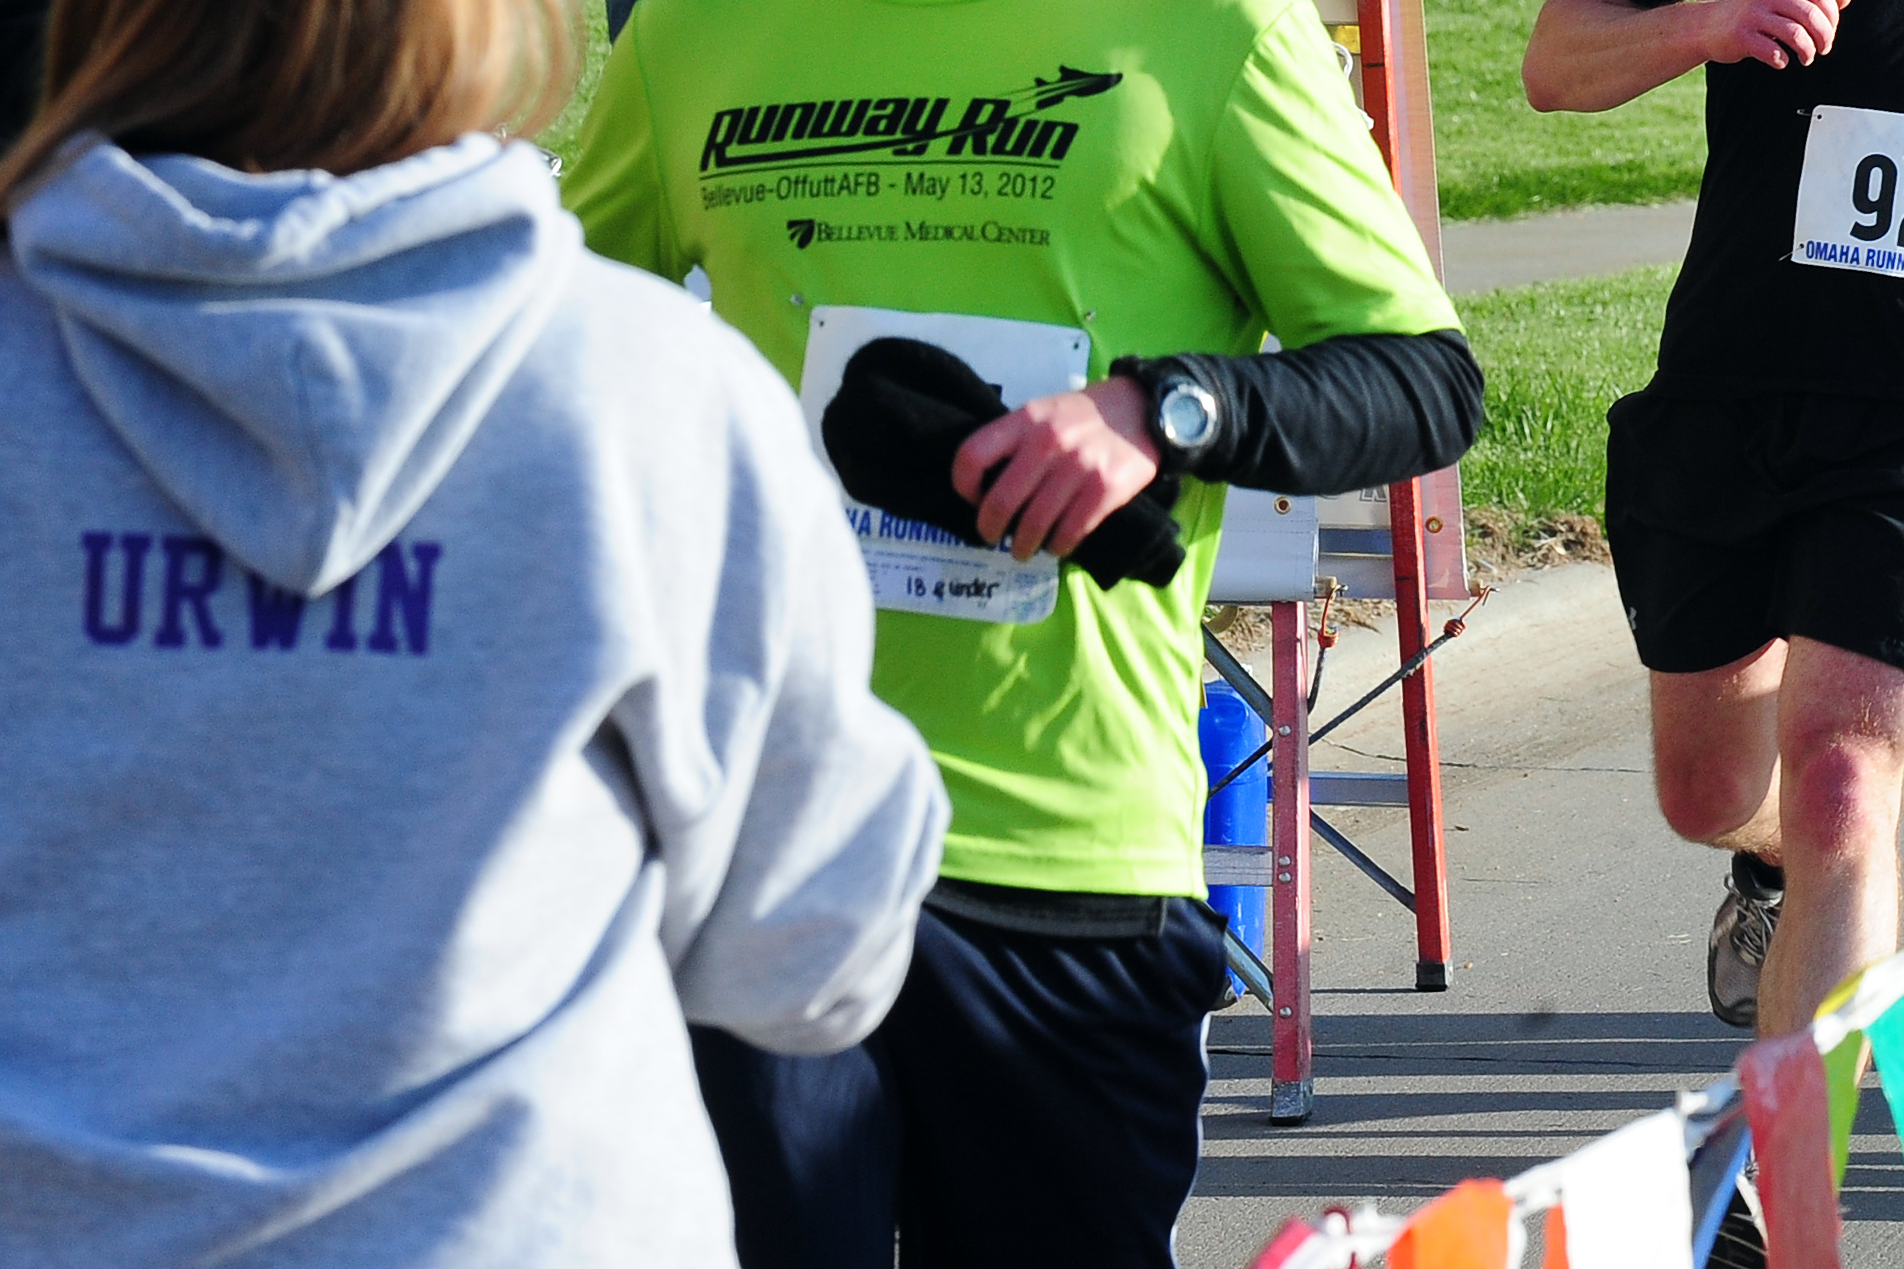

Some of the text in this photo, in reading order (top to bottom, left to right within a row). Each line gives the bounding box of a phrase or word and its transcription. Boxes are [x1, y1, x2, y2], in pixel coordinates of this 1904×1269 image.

[946, 97, 1079, 160] Run
[904, 172, 950, 200] May
[959, 172, 989, 199] 13,
[997, 173, 1056, 200] 2012
[816, 220, 1051, 246] BELLEVUE MEDICAL CENTER
[1806, 240, 1860, 266] OMAHA
[82, 531, 441, 655] URWIN
